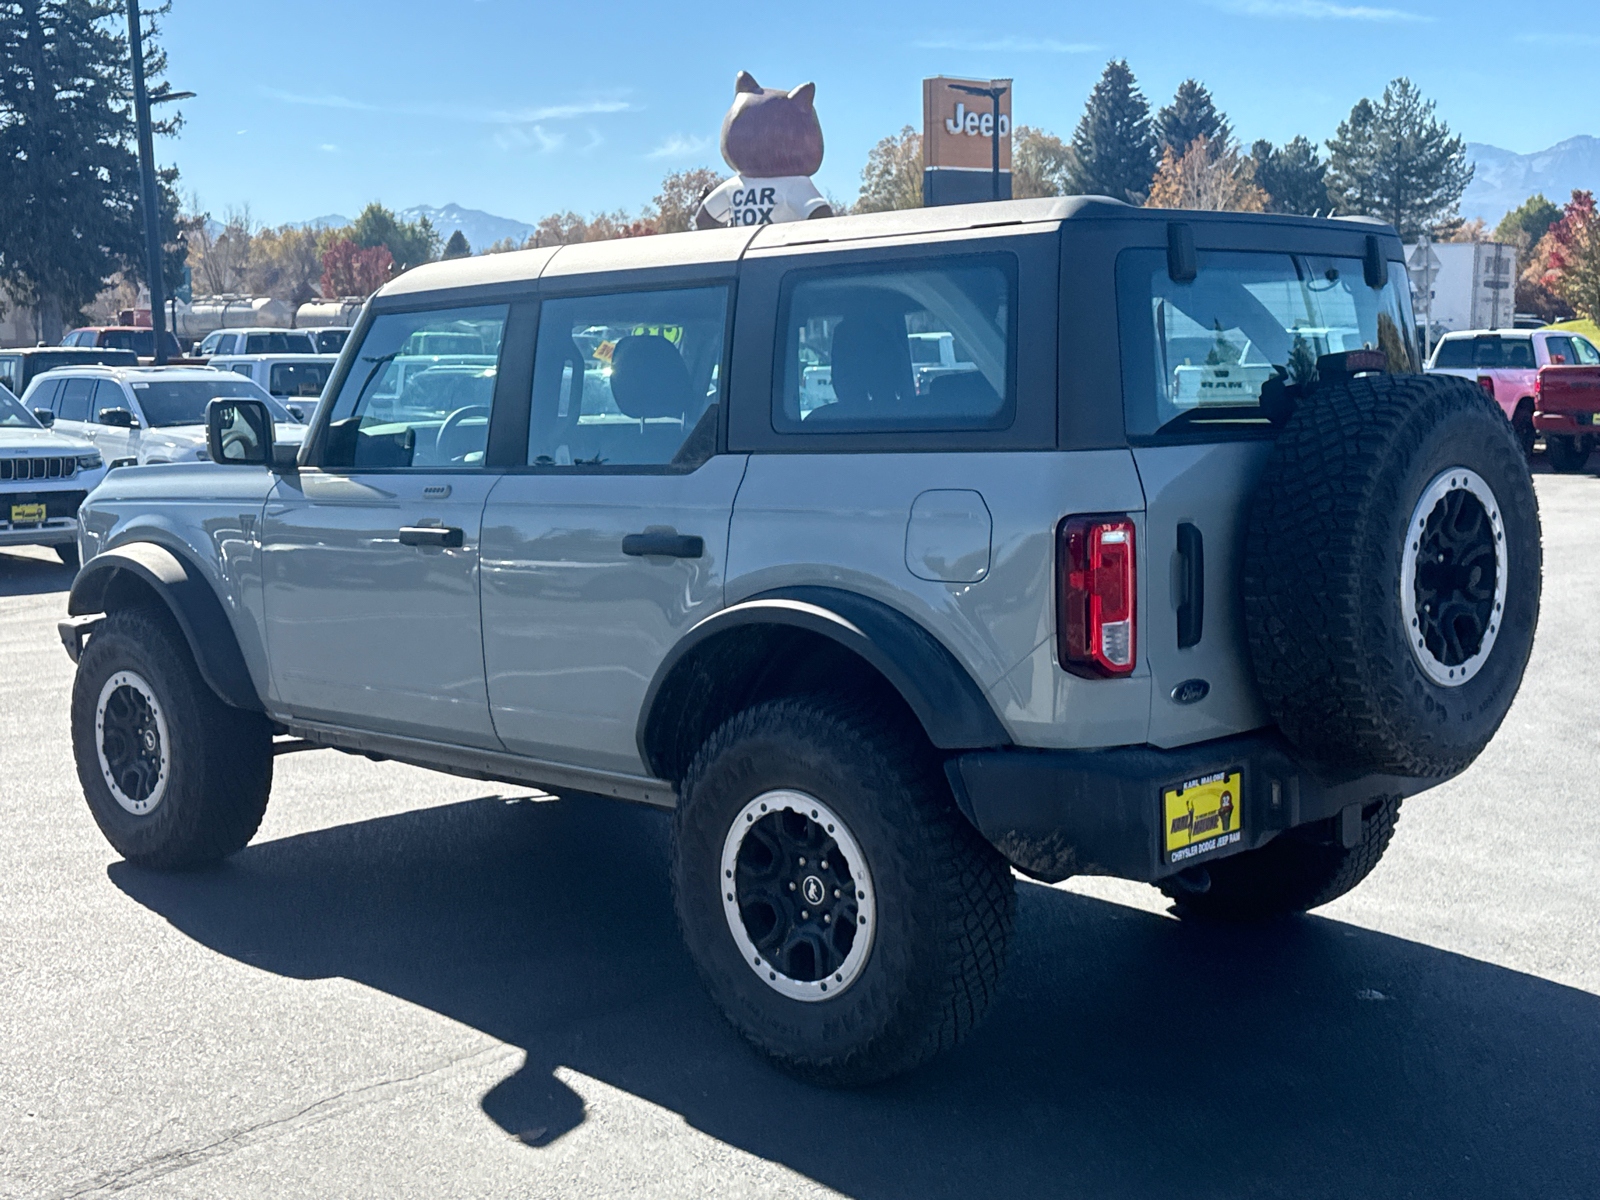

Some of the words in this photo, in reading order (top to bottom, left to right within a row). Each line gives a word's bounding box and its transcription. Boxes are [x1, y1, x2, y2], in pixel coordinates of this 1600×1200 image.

[946, 102, 1010, 138] Jeep
[732, 187, 776, 207] CAR
[733, 207, 774, 227] FOX
[1201, 381, 1242, 389] RAM
[1171, 845, 1197, 863] CHRYSLER
[1198, 839, 1216, 854] DODGE
[1217, 834, 1229, 848] JEEP
[1229, 831, 1241, 844] RAM
